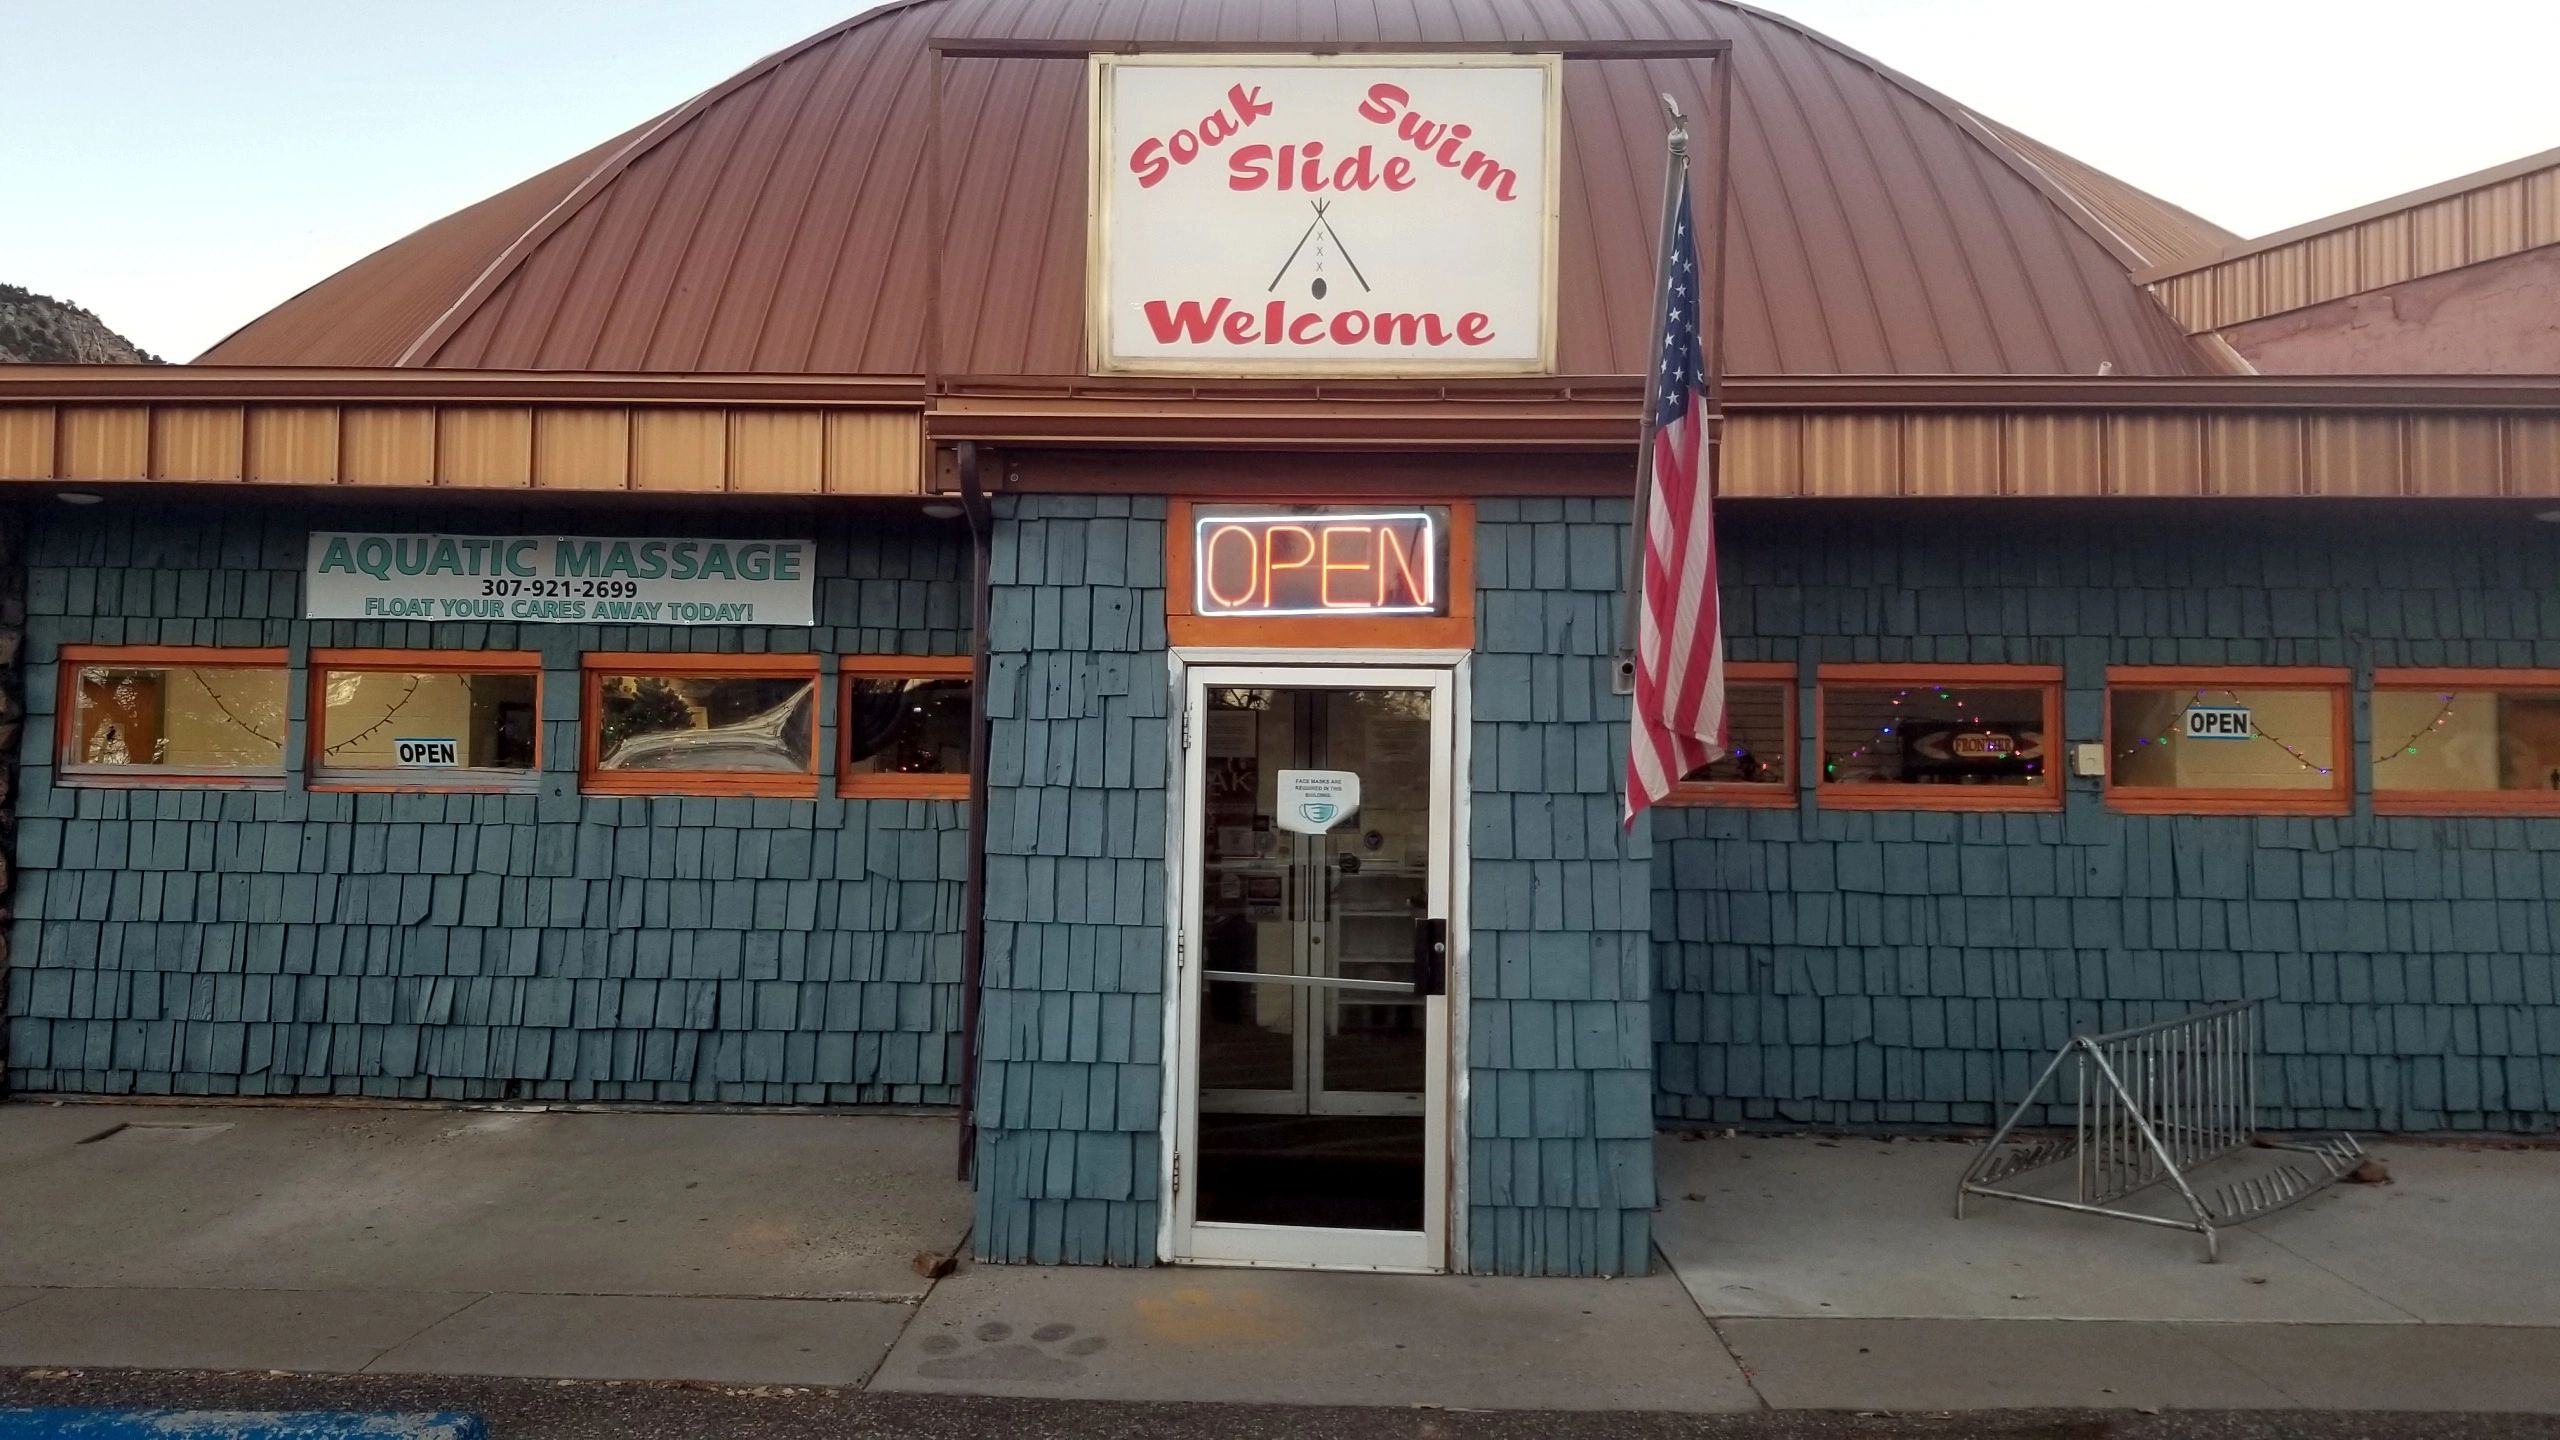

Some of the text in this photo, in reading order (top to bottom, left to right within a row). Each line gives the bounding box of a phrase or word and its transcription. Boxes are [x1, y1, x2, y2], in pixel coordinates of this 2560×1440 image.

[1129, 82, 1274, 189] Soak
[1358, 82, 1518, 202] Swim
[1228, 141, 1417, 192] Slide
[1143, 297, 1496, 346] Welcome
[318, 536, 801, 581] AQUATIC MASSAGE
[1207, 524, 1429, 608] OPEN
[364, 597, 754, 622] FLOAT YOUR CARES AWAY TODAY!
[481, 579, 638, 599] 307-921-2699
[2190, 712, 2248, 734] OPEN
[399, 743, 455, 763] OPEN
